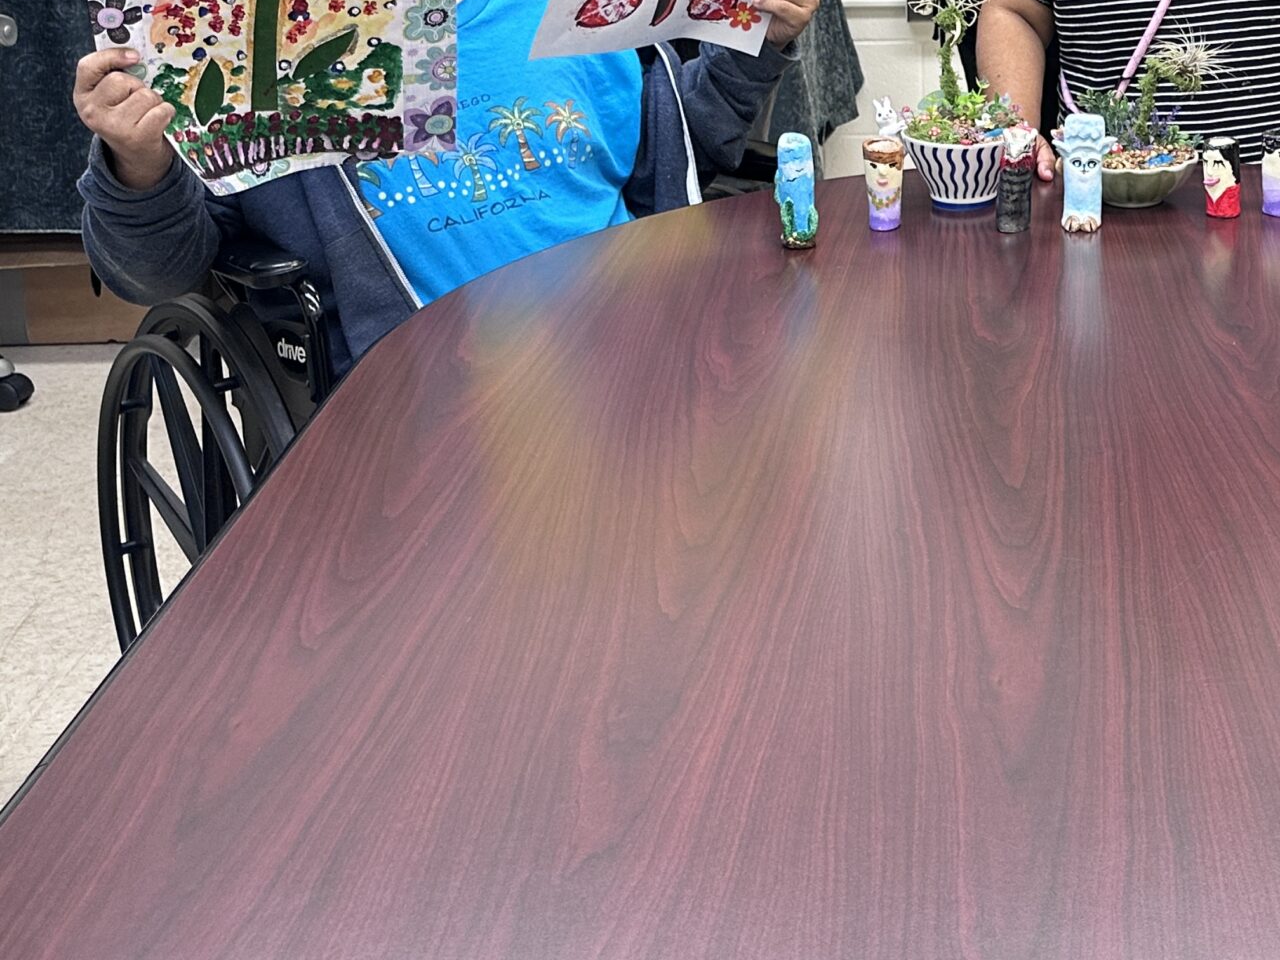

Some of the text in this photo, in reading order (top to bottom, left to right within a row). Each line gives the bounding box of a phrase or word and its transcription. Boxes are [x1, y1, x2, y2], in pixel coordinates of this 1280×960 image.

[457, 93, 491, 111] EGO
[427, 189, 552, 233] CALIFORNA
[277, 337, 306, 364] drive
